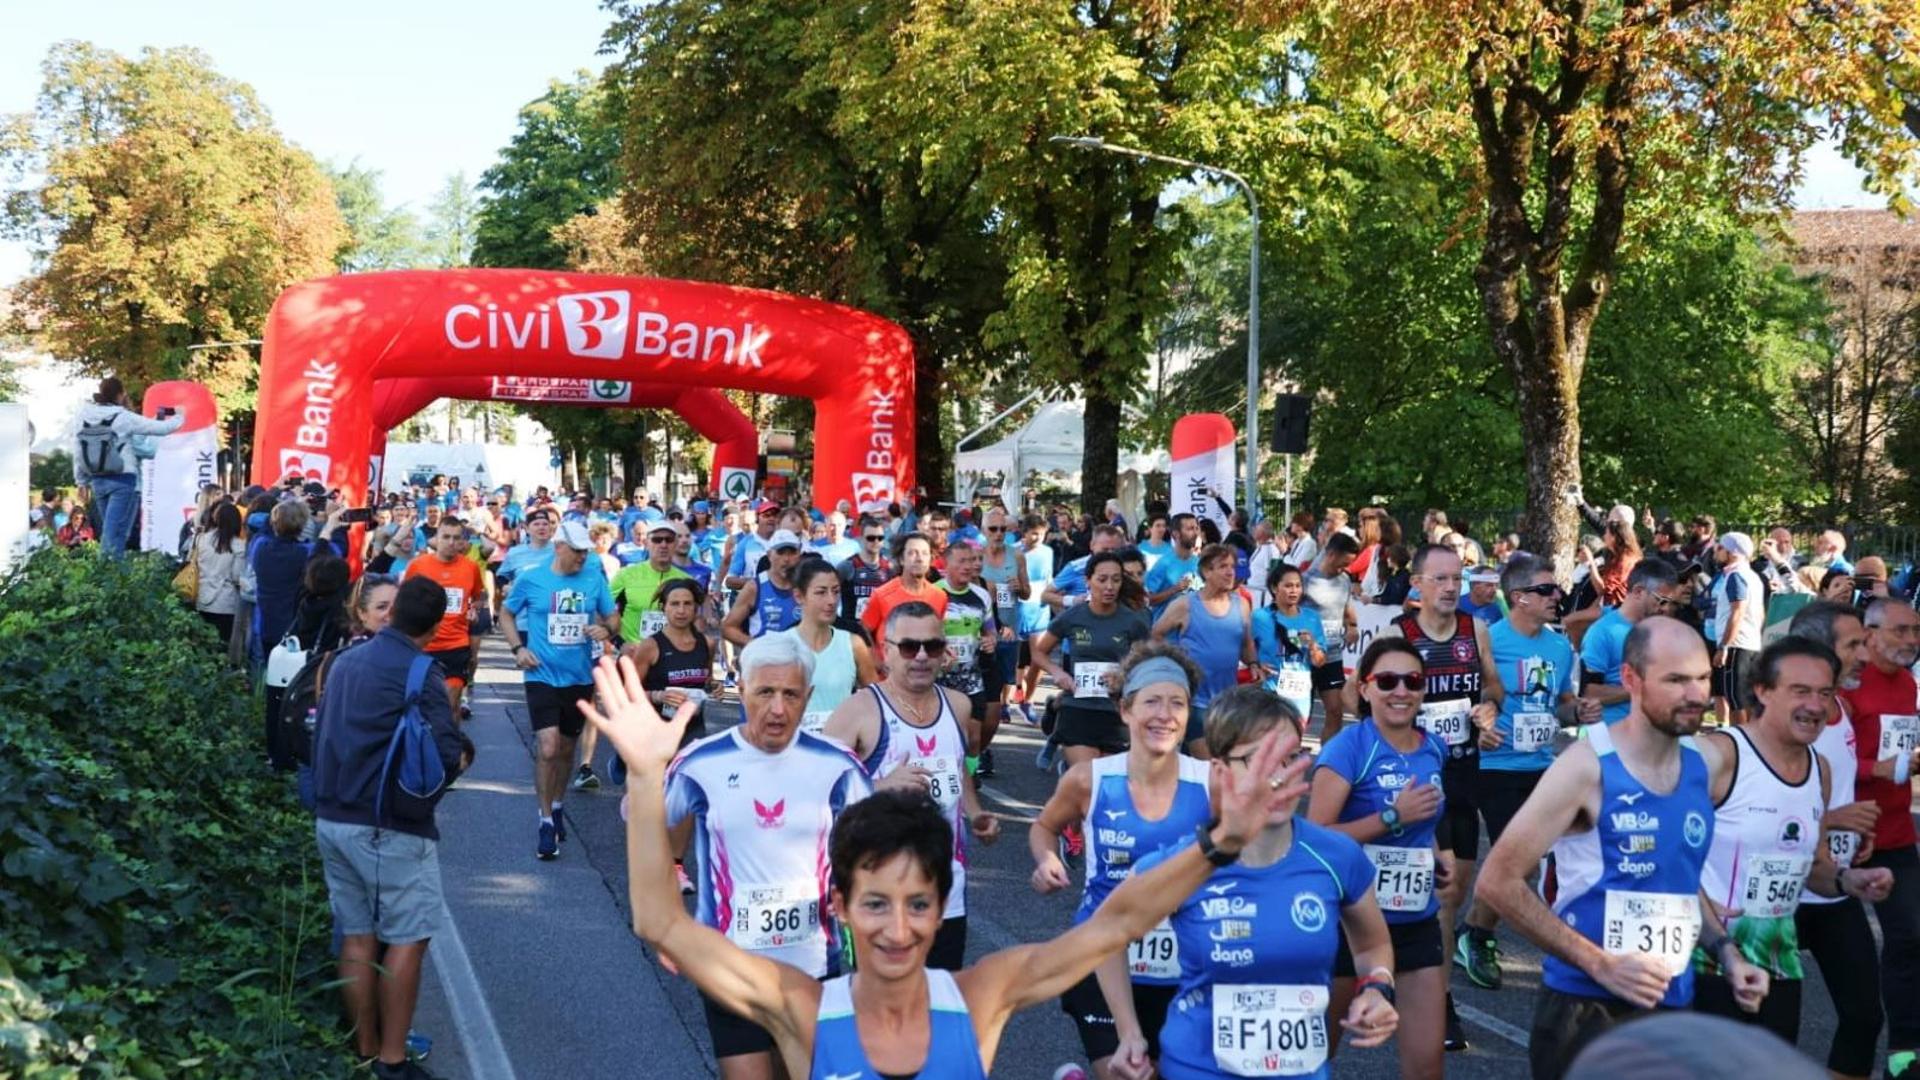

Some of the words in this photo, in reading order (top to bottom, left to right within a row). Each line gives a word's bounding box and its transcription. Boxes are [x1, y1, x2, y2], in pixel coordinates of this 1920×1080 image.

[444, 303, 550, 349] Civi
[635, 311, 772, 368] Bank
[296, 359, 337, 449] Bank
[866, 388, 895, 469] Bank
[194, 451, 213, 503] ank
[560, 626, 579, 636] 272
[1434, 716, 1460, 735] 509
[1530, 727, 1550, 742] 120
[1377, 870, 1423, 894] F115
[1767, 881, 1798, 902] 546
[761, 907, 800, 932] 366
[1637, 924, 1683, 955] 318
[1240, 1018, 1308, 1051] F180
